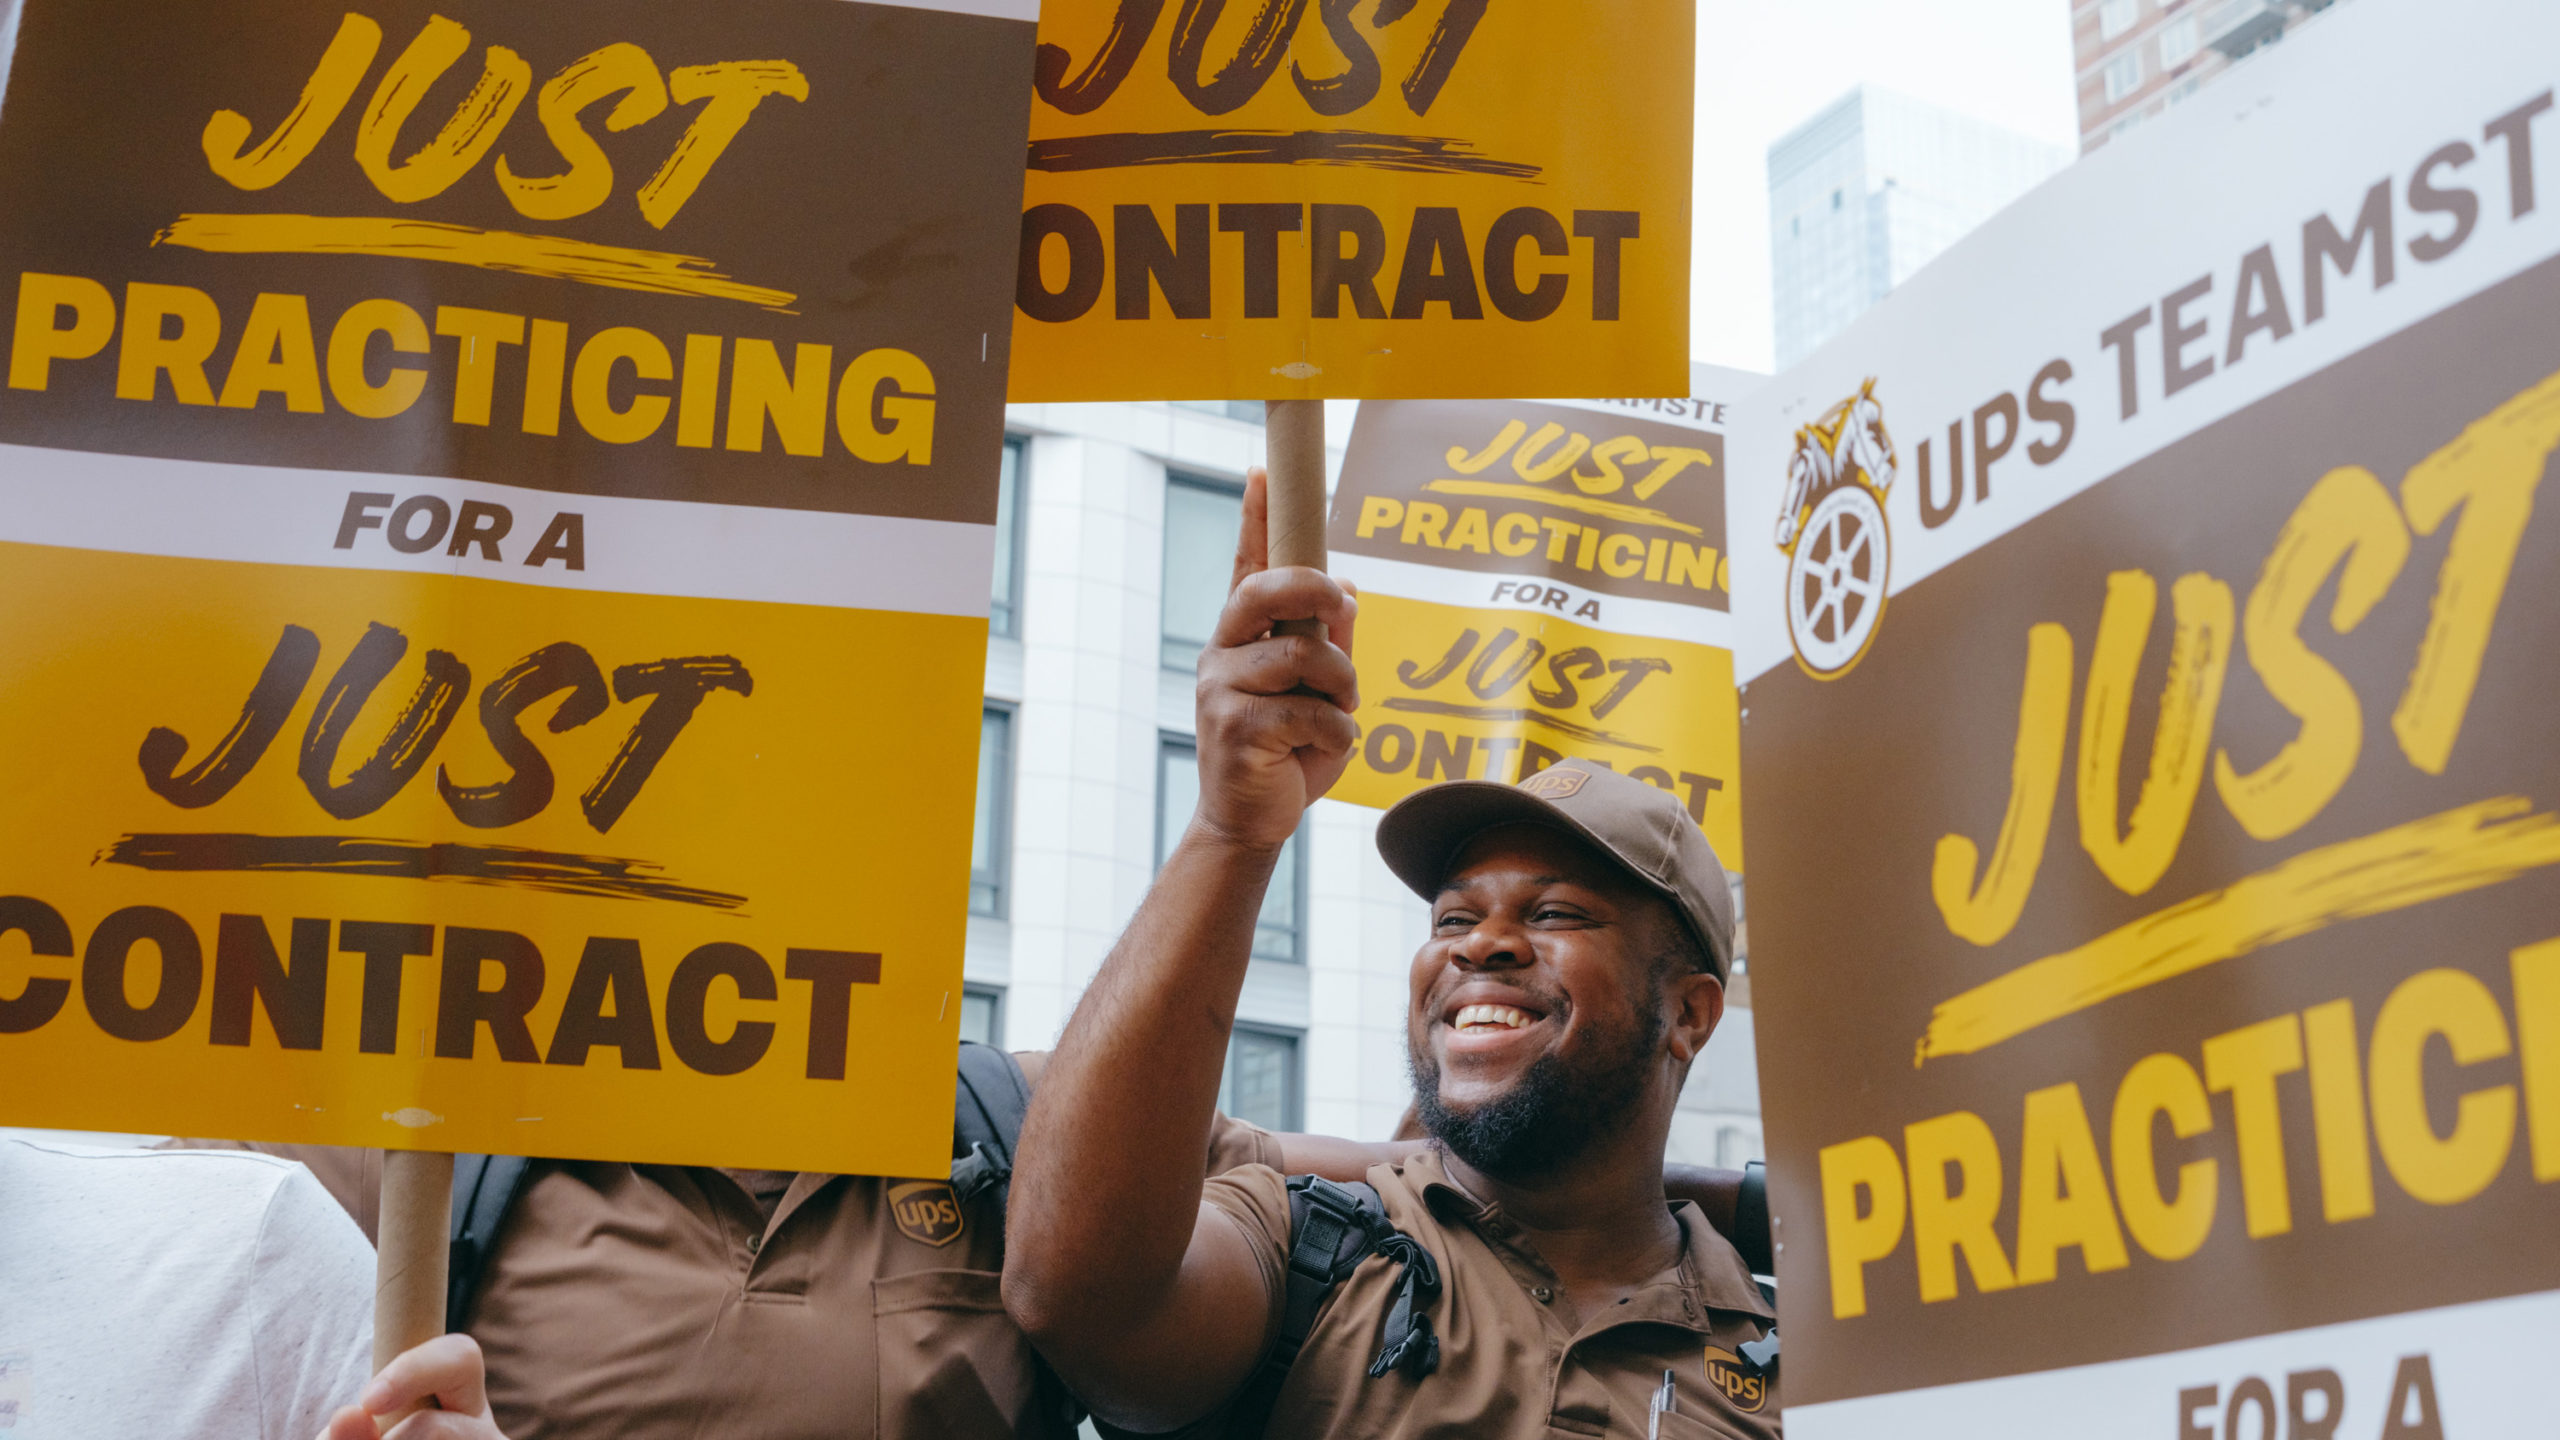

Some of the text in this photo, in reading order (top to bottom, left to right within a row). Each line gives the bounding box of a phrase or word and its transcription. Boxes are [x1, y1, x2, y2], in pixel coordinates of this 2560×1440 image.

[202, 12, 810, 230] JUST
[1916, 88, 2553, 530] UPS TEAMST
[8, 271, 936, 466] PRACTICING
[1446, 420, 1712, 500] JUST
[333, 492, 586, 572] FOR A
[1356, 496, 1729, 594] PRACTICIN
[1489, 581, 1601, 622] FOR A
[1397, 627, 1672, 719] JUST
[1932, 369, 2560, 946] JUST
[138, 621, 754, 834] JUST
[0, 894, 883, 1080] CONTRACT
[898, 1200, 957, 1235] ups
[1709, 1361, 1760, 1400] ups
[2381, 1354, 2445, 1440] A
